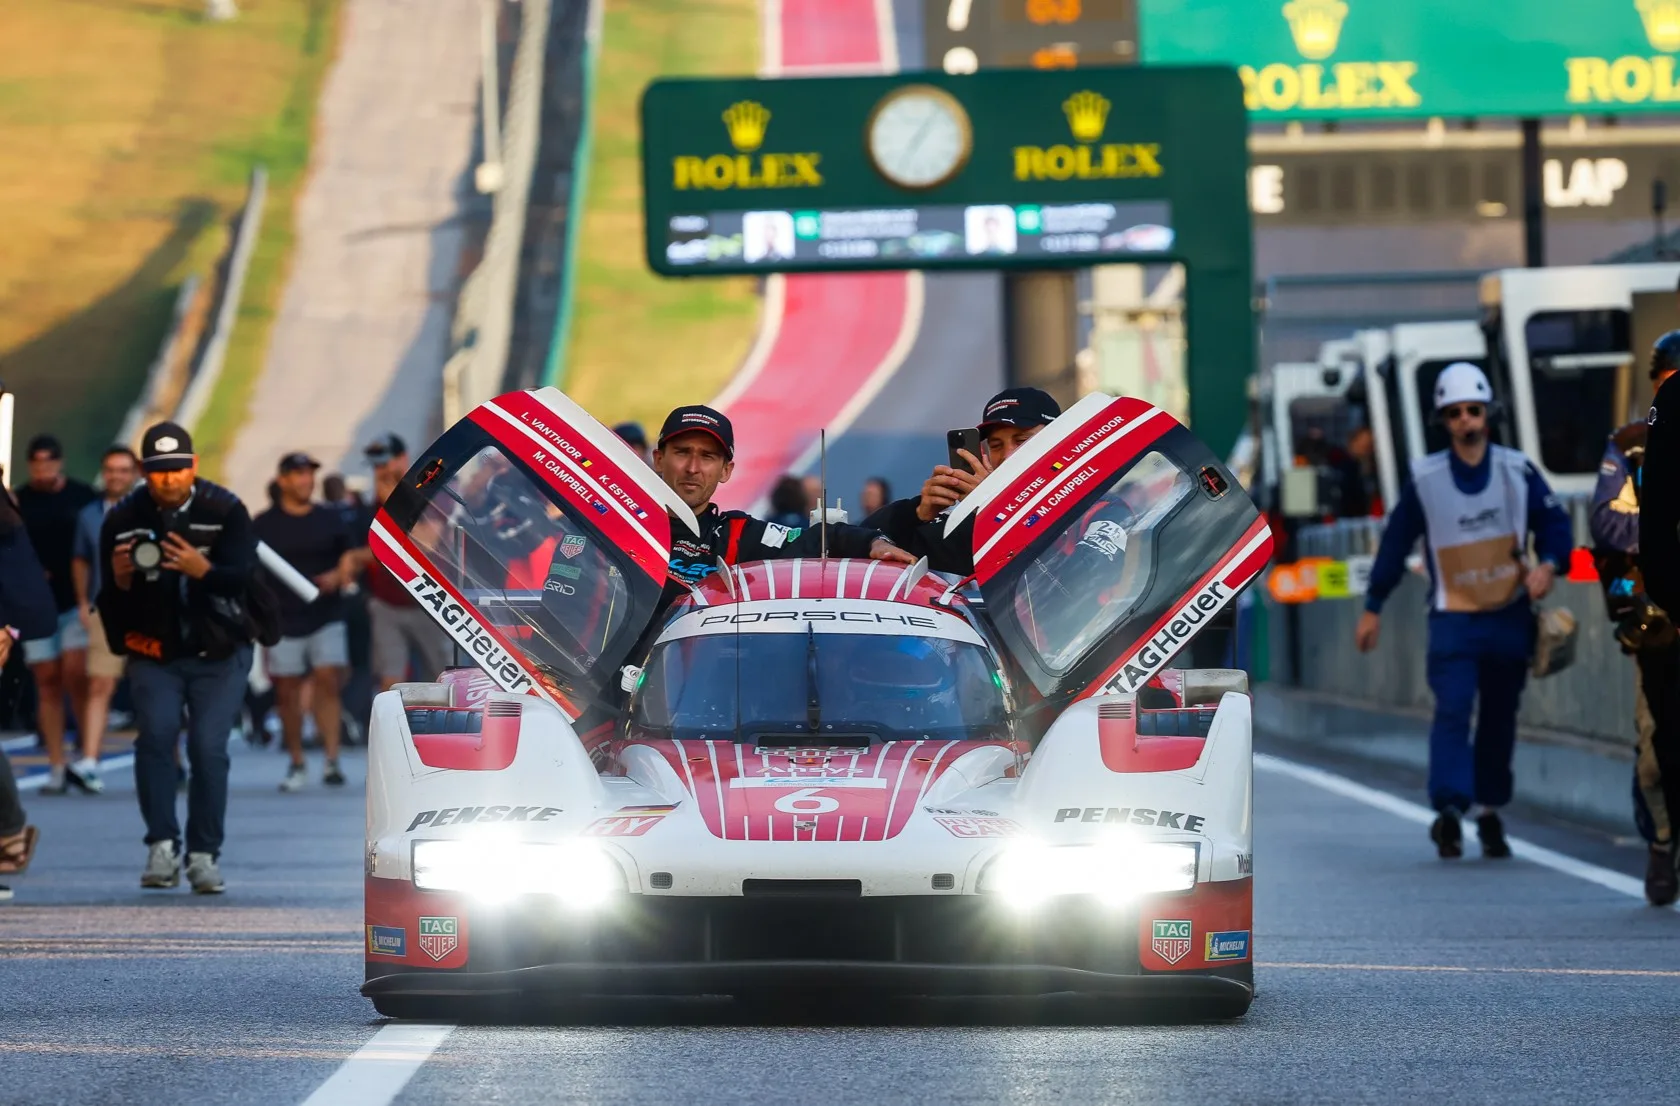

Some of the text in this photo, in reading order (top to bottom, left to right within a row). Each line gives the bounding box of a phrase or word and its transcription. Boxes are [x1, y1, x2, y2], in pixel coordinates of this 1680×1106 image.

[673, 152, 822, 190] ROLEX
[1013, 143, 1163, 181] ROLEX
[1543, 158, 1628, 207] LAP
[521, 412, 639, 510] L. VANTHOOR K. ESTRE
[1005, 503, 1018, 512] K.
[1015, 477, 1046, 502] ESTRE
[1071, 415, 1124, 453] VANTHOOR
[533, 451, 594, 503] M. CAMPBELL
[1036, 466, 1099, 516] M. CAMPBELL
[561, 545, 584, 556] HEUER
[565, 537, 584, 545] TAG
[544, 578, 575, 595] GRID
[700, 611, 938, 628] PORSCHE
[774, 788, 839, 814] 6
[405, 805, 563, 832] PENSKE
[1054, 807, 1205, 833] PENSKE
[422, 920, 454, 932] TAG
[1156, 924, 1188, 936] TAG
[421, 937, 454, 957] HEUER
[1155, 940, 1189, 960] HEUER
[1219, 941, 1245, 952] MICHELIN
